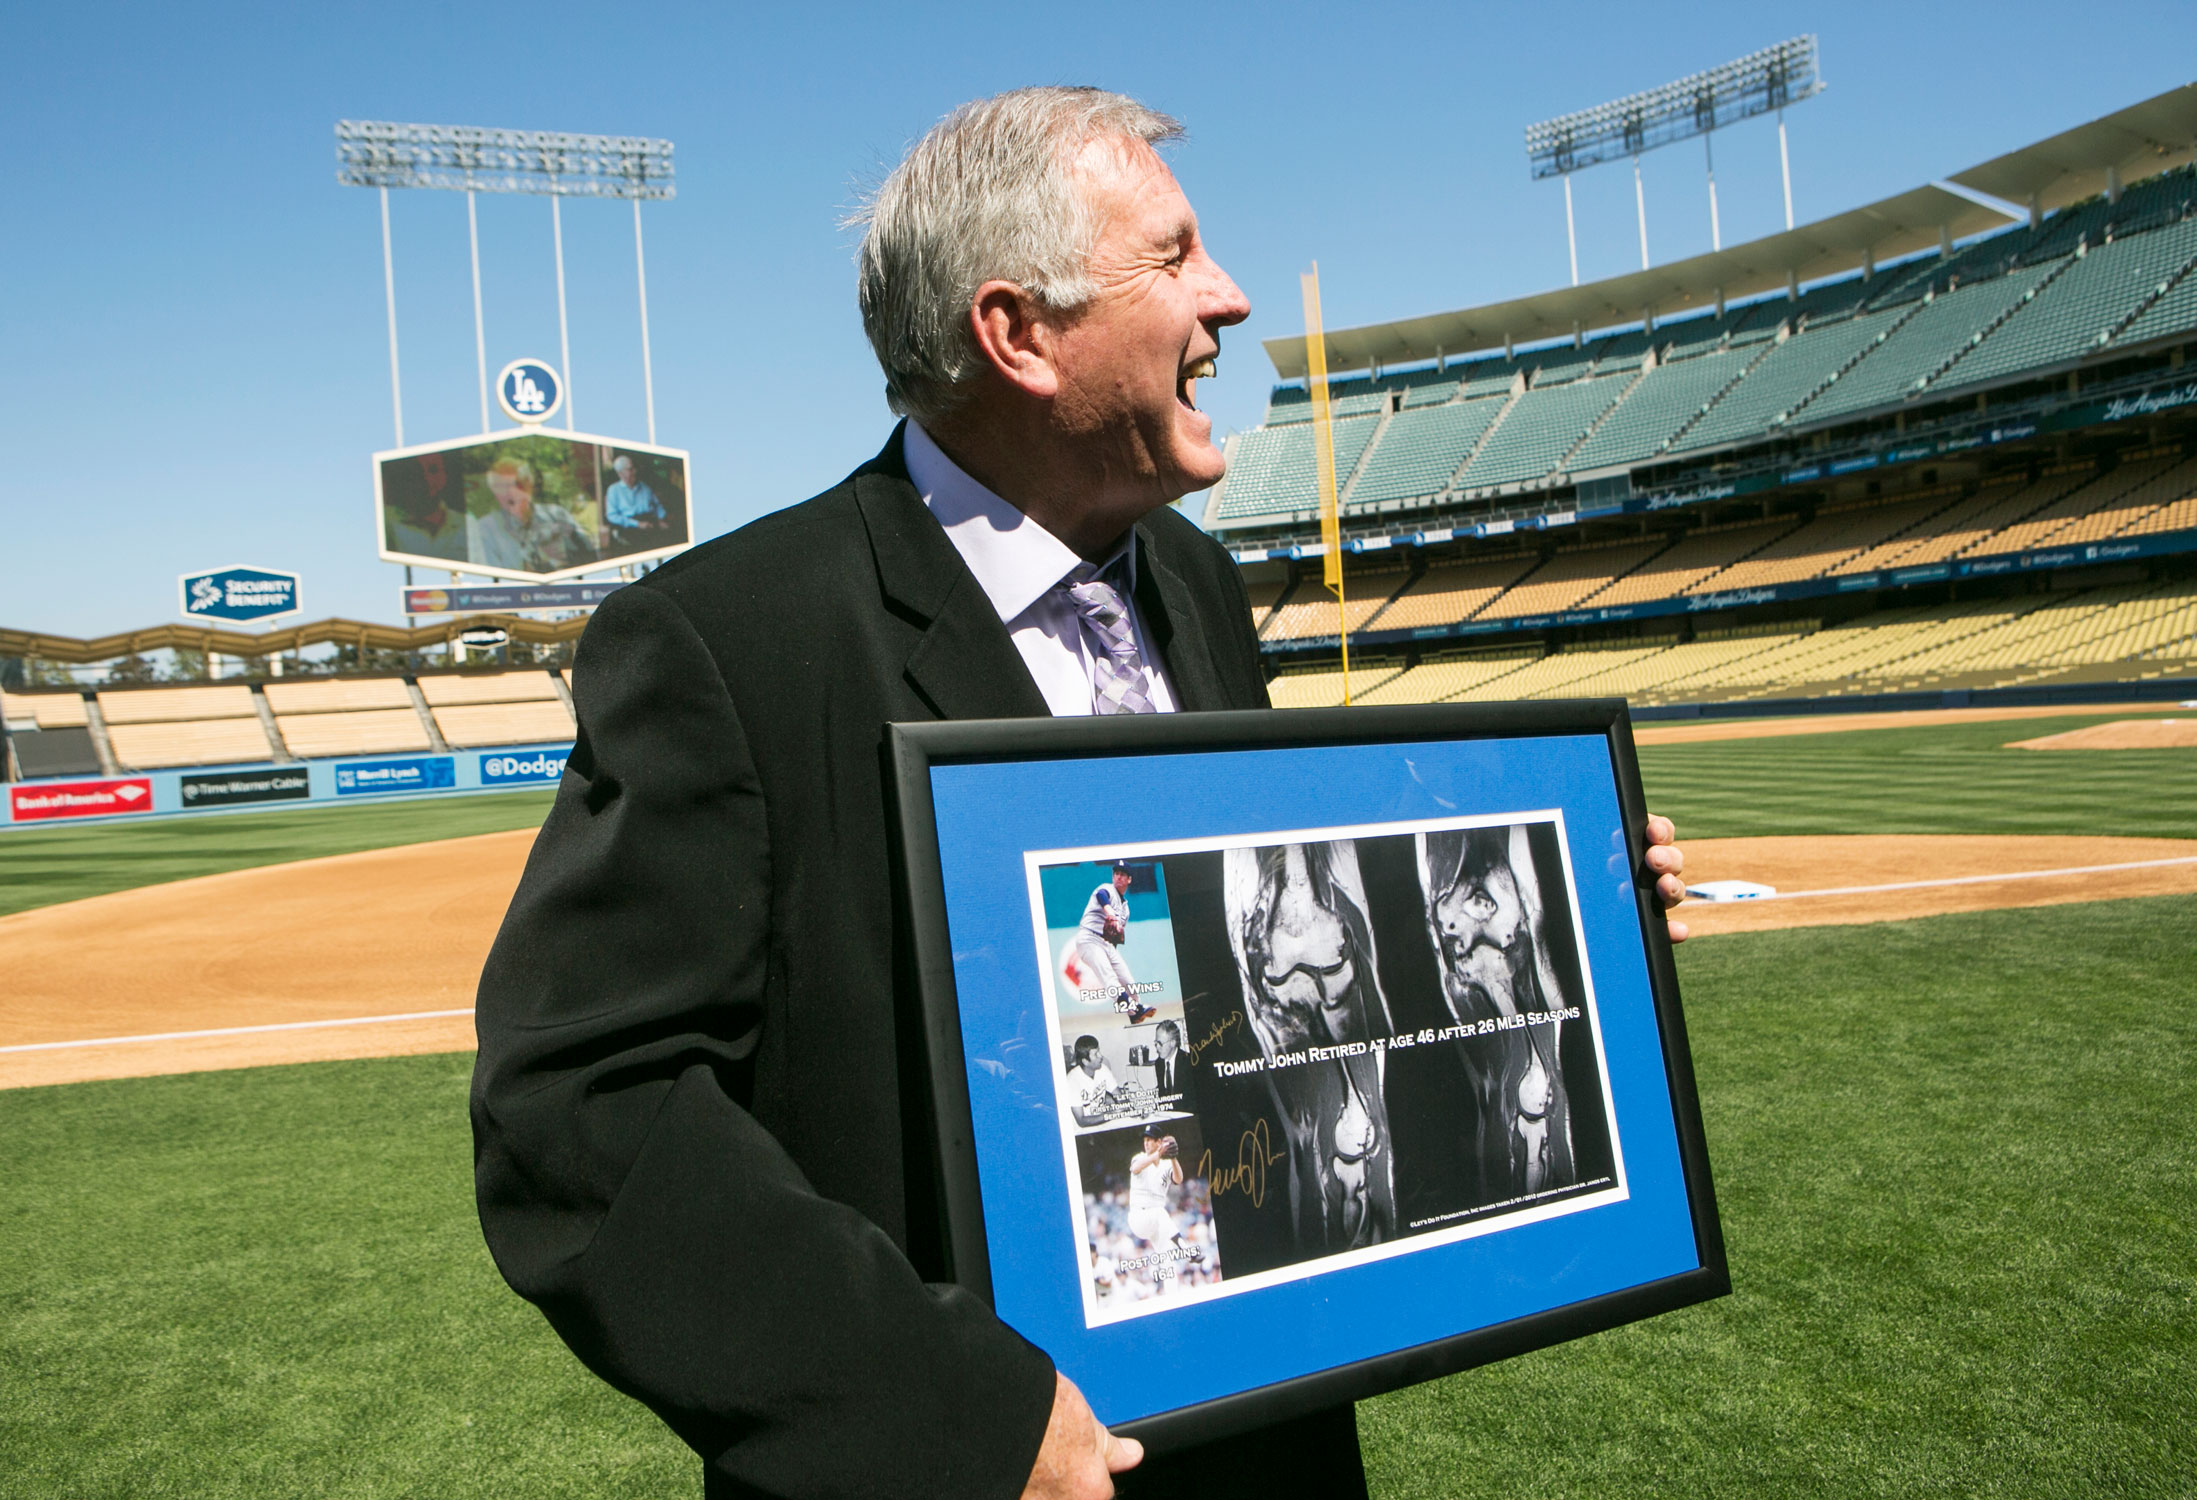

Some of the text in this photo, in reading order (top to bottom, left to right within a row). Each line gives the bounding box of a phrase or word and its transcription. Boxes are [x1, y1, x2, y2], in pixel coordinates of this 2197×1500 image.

[511, 368, 546, 412] LA
[225, 579, 293, 594] SECURITY
[390, 767, 420, 781] Lynch
[485, 753, 568, 778] @Dodge
[198, 777, 306, 795] Time Warner Cable
[16, 791, 116, 810] Bank of America
[1080, 981, 1164, 1002] PRE OP WINS:
[1213, 1007, 1581, 1078] TOMMY JOHN RETIRED AT AGE 46 AFTER 26 MLB SEASONS
[1111, 1102, 1134, 1111] TOMMY
[1134, 1099, 1154, 1108] JOHN
[1154, 1093, 1183, 1104] SURGERY
[1156, 1102, 1174, 1112] 1974
[1120, 1245, 1201, 1272] POST OP WINS:
[1153, 1267, 1175, 1283] 164
